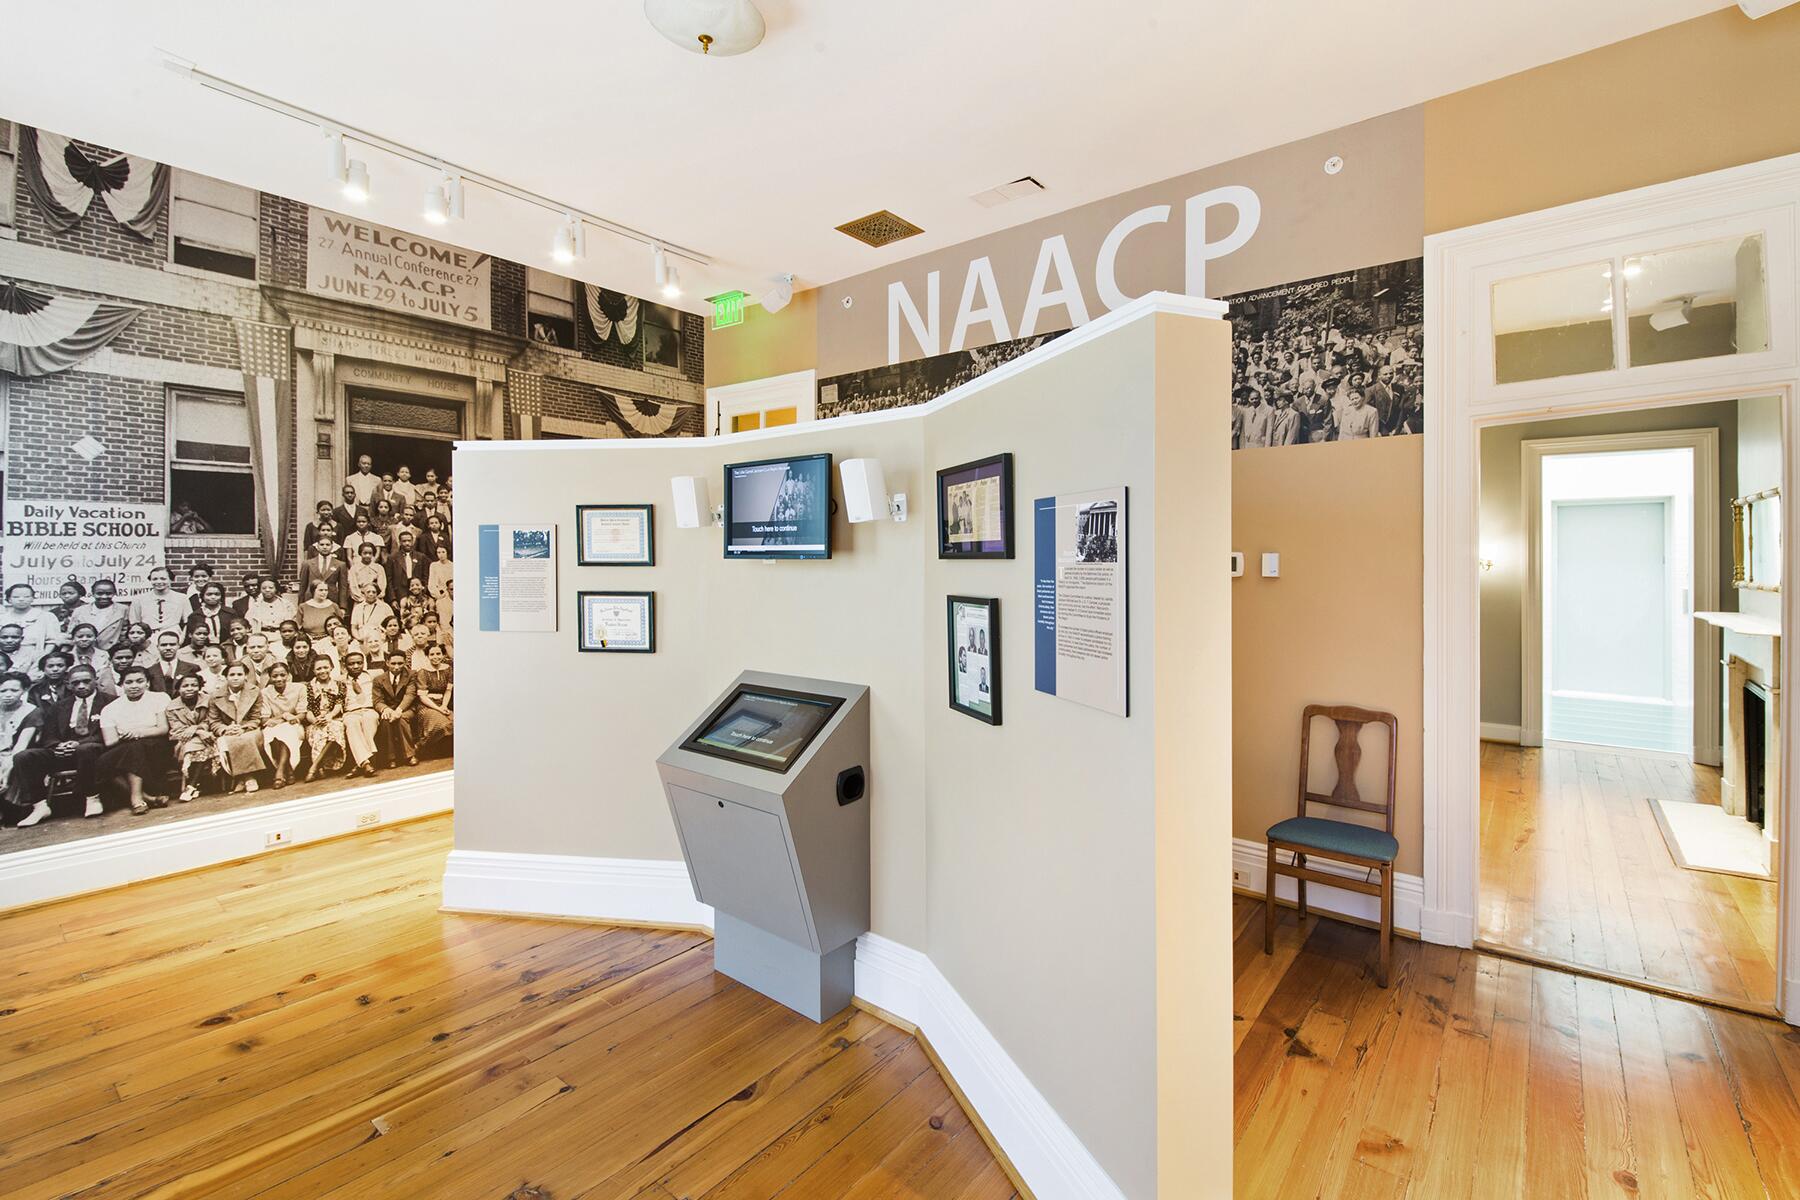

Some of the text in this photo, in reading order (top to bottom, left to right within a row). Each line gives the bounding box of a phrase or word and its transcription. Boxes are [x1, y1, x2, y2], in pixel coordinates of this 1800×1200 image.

[323, 216, 490, 273] WELCOME!
[318, 236, 480, 287] 27 Annual Conference 27
[354, 263, 457, 299] N.A.A.C.P.
[888, 185, 1262, 365] NAACP
[1248, 287, 1295, 301] ADVANCEMENT
[1296, 280, 1329, 294] COLORED
[1331, 274, 1358, 287] PEOPLE
[319, 274, 371, 298] JUNE
[401, 292, 416, 309] to
[417, 296, 461, 318] JULY
[463, 305, 479, 323] 5
[353, 367, 460, 393] COMMUNITY HOUSE
[24, 504, 146, 520] Daily Vacation
[6, 521, 160, 538] BIBLE SCHOOL
[751, 525, 763, 533] Touch
[779, 524, 798, 532] continue
[23, 540, 147, 550] Will be held at this Church
[9, 554, 57, 570] July
[59, 554, 74, 569] 6
[94, 553, 133, 570] July
[134, 553, 157, 567] 24
[33, 590, 60, 600] CHILD
